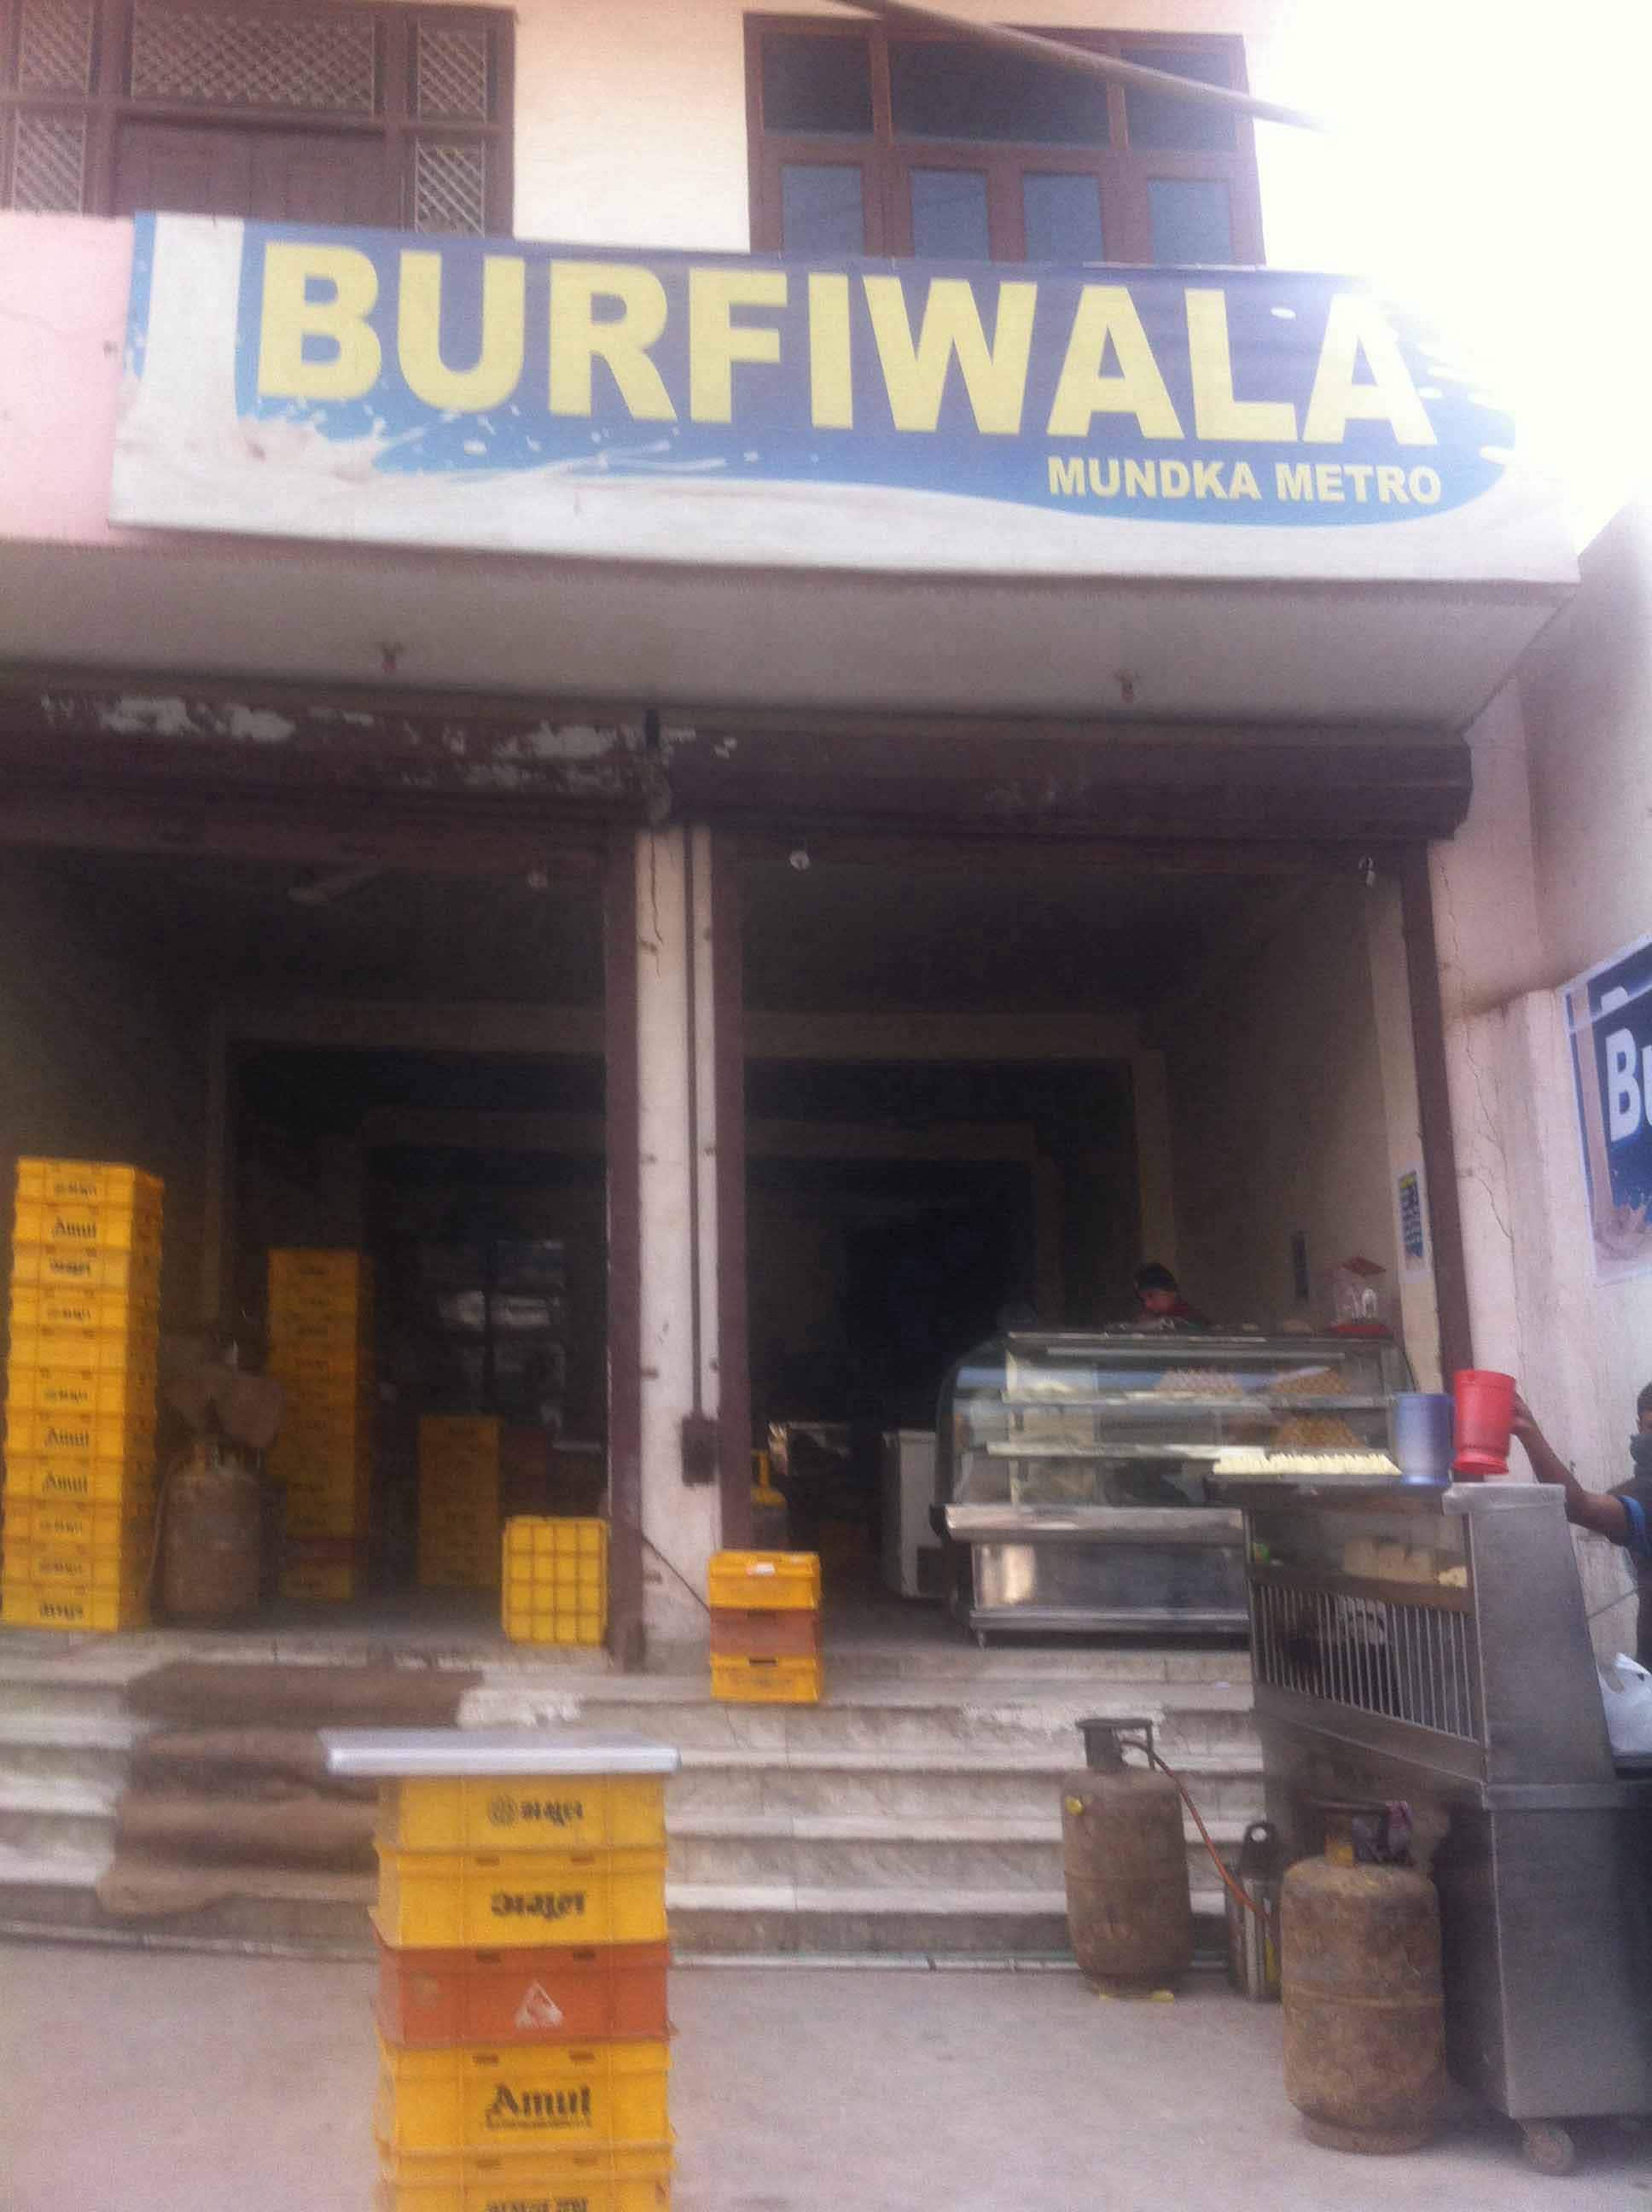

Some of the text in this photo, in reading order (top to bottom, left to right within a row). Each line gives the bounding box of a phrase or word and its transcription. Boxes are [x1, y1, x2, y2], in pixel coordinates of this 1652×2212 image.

[259, 242, 1438, 445] BURFIWALA
[1048, 457, 1442, 505] MUNDKA METRO
[1605, 1027, 1652, 1143] B
[486, 2082, 591, 2120] Amul
